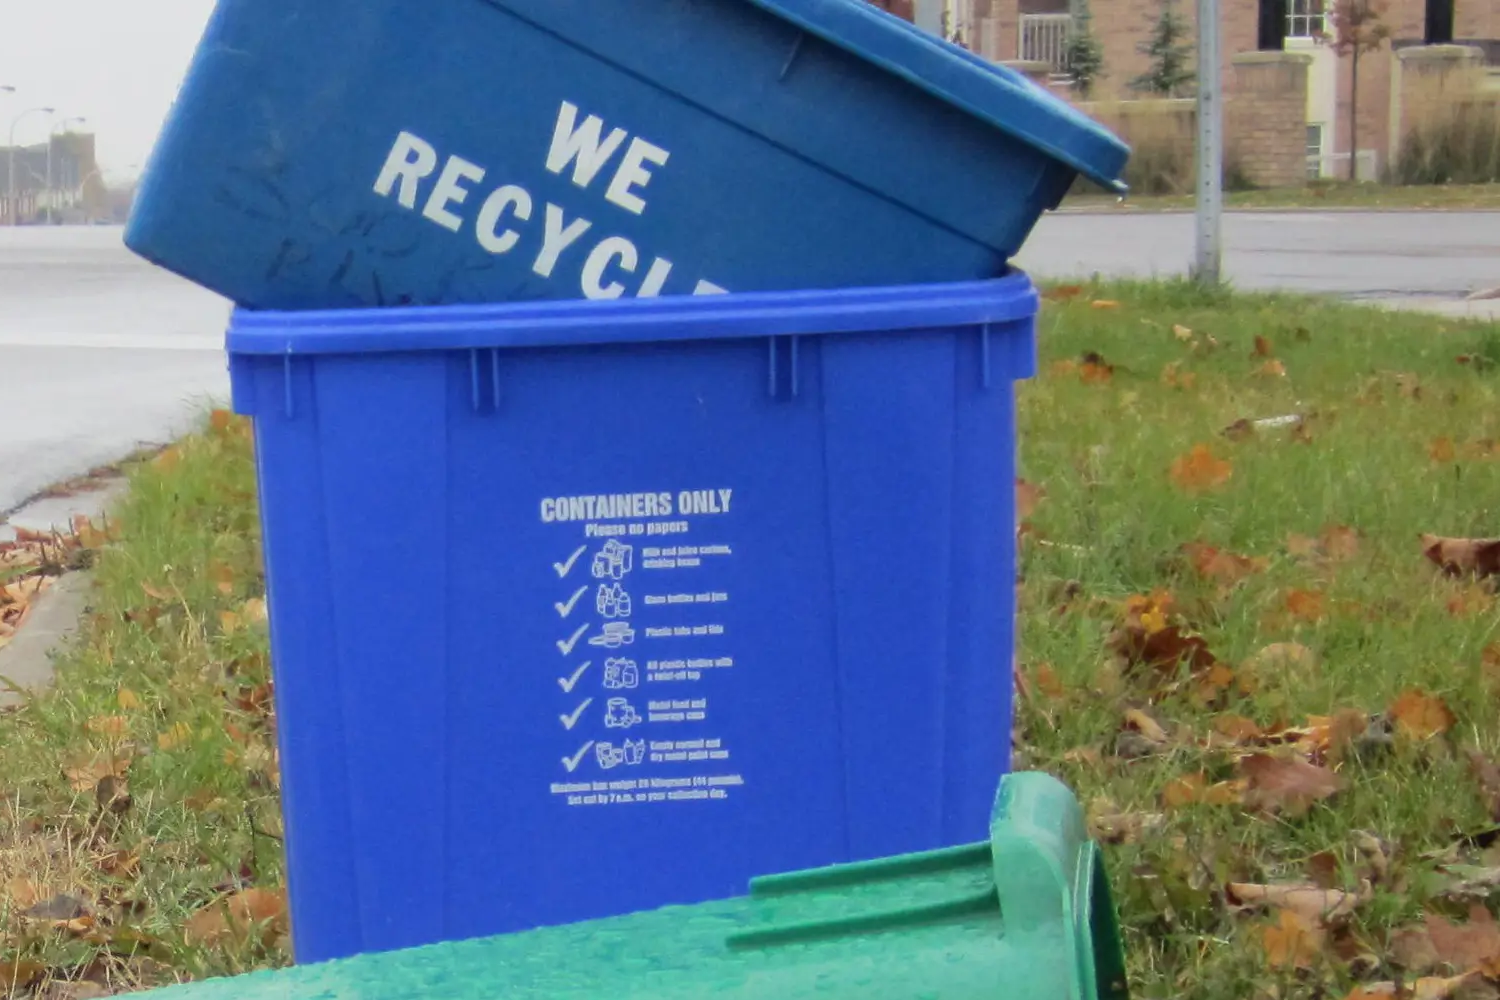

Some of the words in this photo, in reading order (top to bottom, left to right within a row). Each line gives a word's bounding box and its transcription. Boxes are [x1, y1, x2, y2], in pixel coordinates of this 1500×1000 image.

[545, 100, 670, 215] WE
[373, 131, 730, 299] RECYCL
[541, 493, 672, 522] CONTAINERS
[679, 489, 731, 514] ONLY
[585, 524, 626, 537] Please
[630, 524, 644, 534] no
[647, 521, 688, 536] papers
